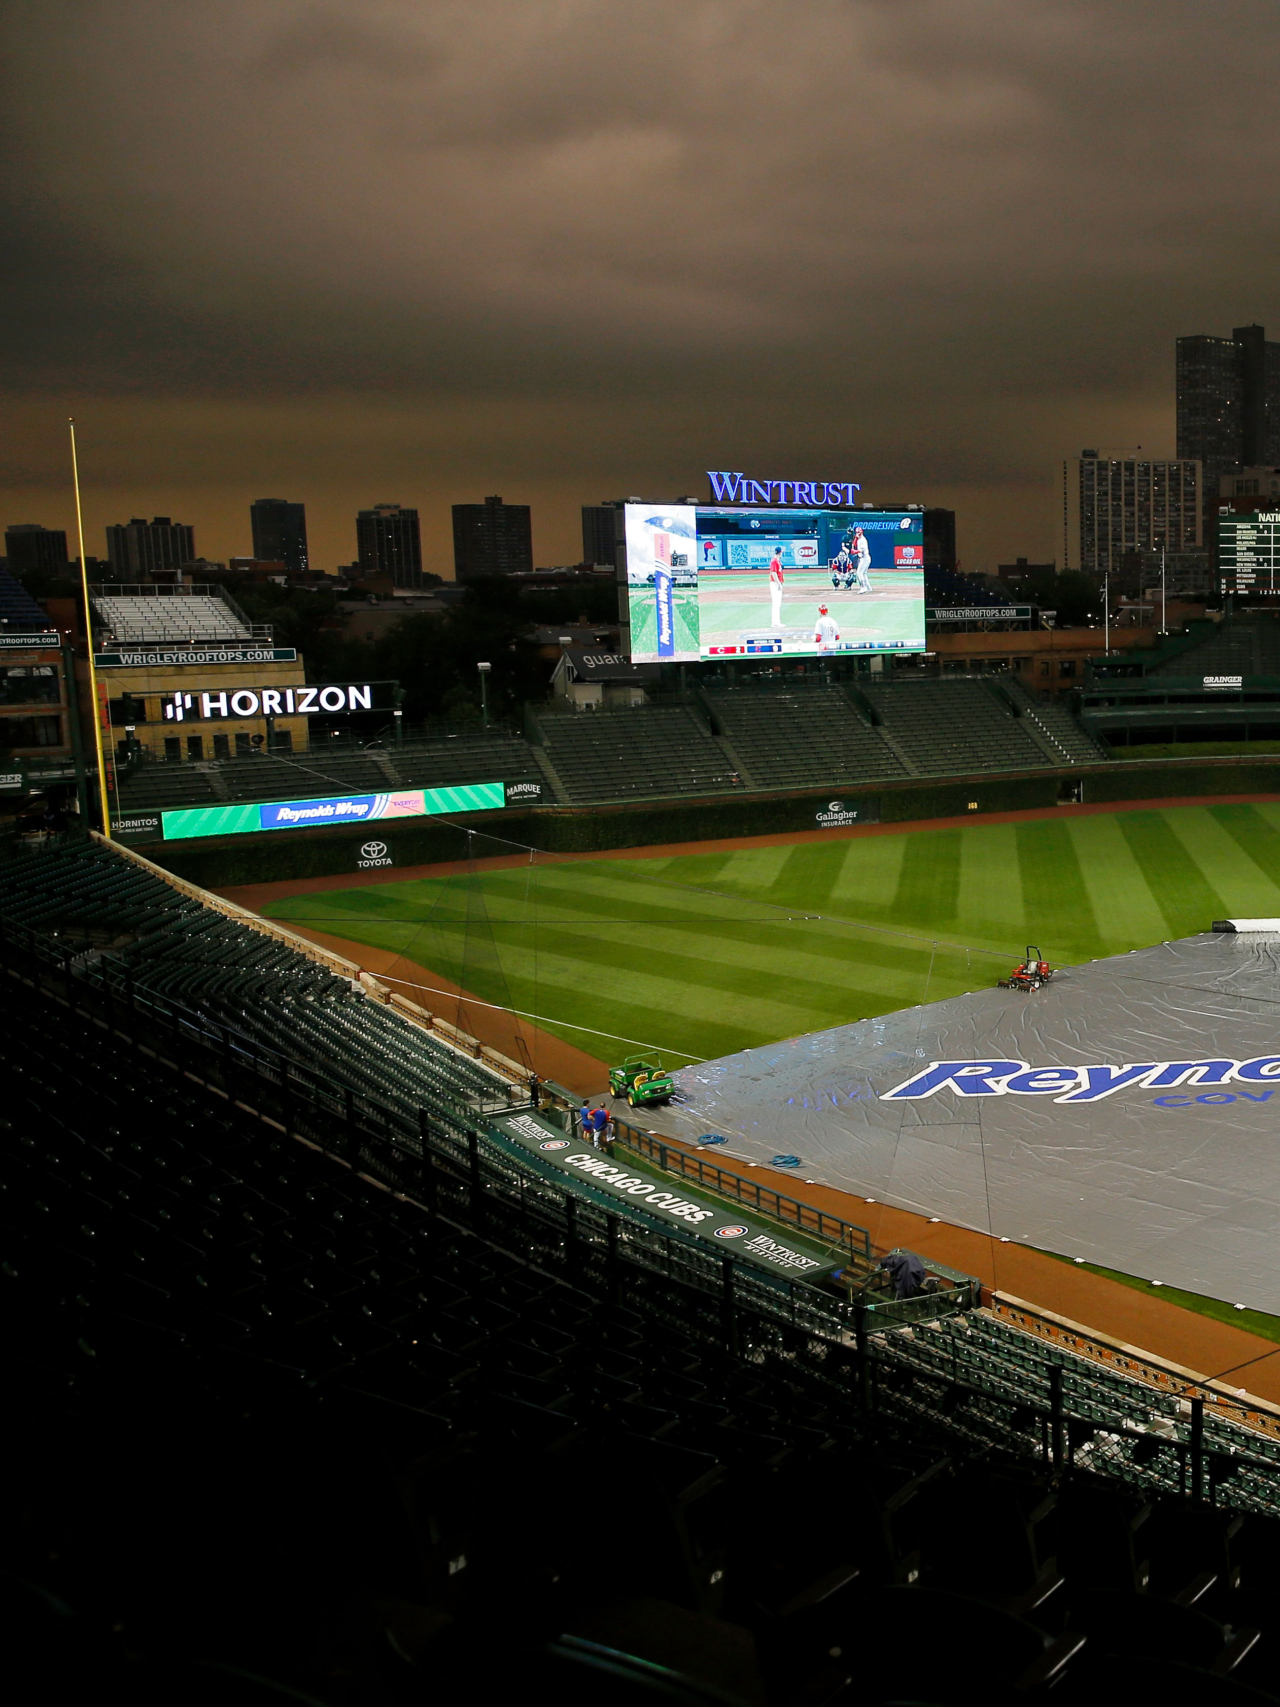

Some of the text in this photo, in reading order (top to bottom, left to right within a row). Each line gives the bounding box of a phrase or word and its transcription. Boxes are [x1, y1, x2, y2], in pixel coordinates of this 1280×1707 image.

[707, 471, 861, 506] WINTRUST
[853, 522, 901, 530] PROGRESSIVE
[935, 609, 1017, 618] WRIGLEYROOFTOPS.COM
[120, 651, 275, 665] WRIGLEYROOFTOPS.COM
[203, 685, 372, 719] HORIZON
[506, 783, 541, 796] MARQUEE
[277, 802, 369, 823] Reynolds Wrap
[816, 811, 858, 821] Gallagher
[112, 818, 158, 828] HORNITOS
[821, 819, 852, 828] INSURANCE
[358, 858, 393, 868] TOYOTA
[513, 1114, 555, 1141] WINTRUST
[564, 1153, 715, 1224] CHICAGO CUBS
[744, 1243, 792, 1268] MORTGAGE
[750, 1234, 820, 1270] WINTRUST
